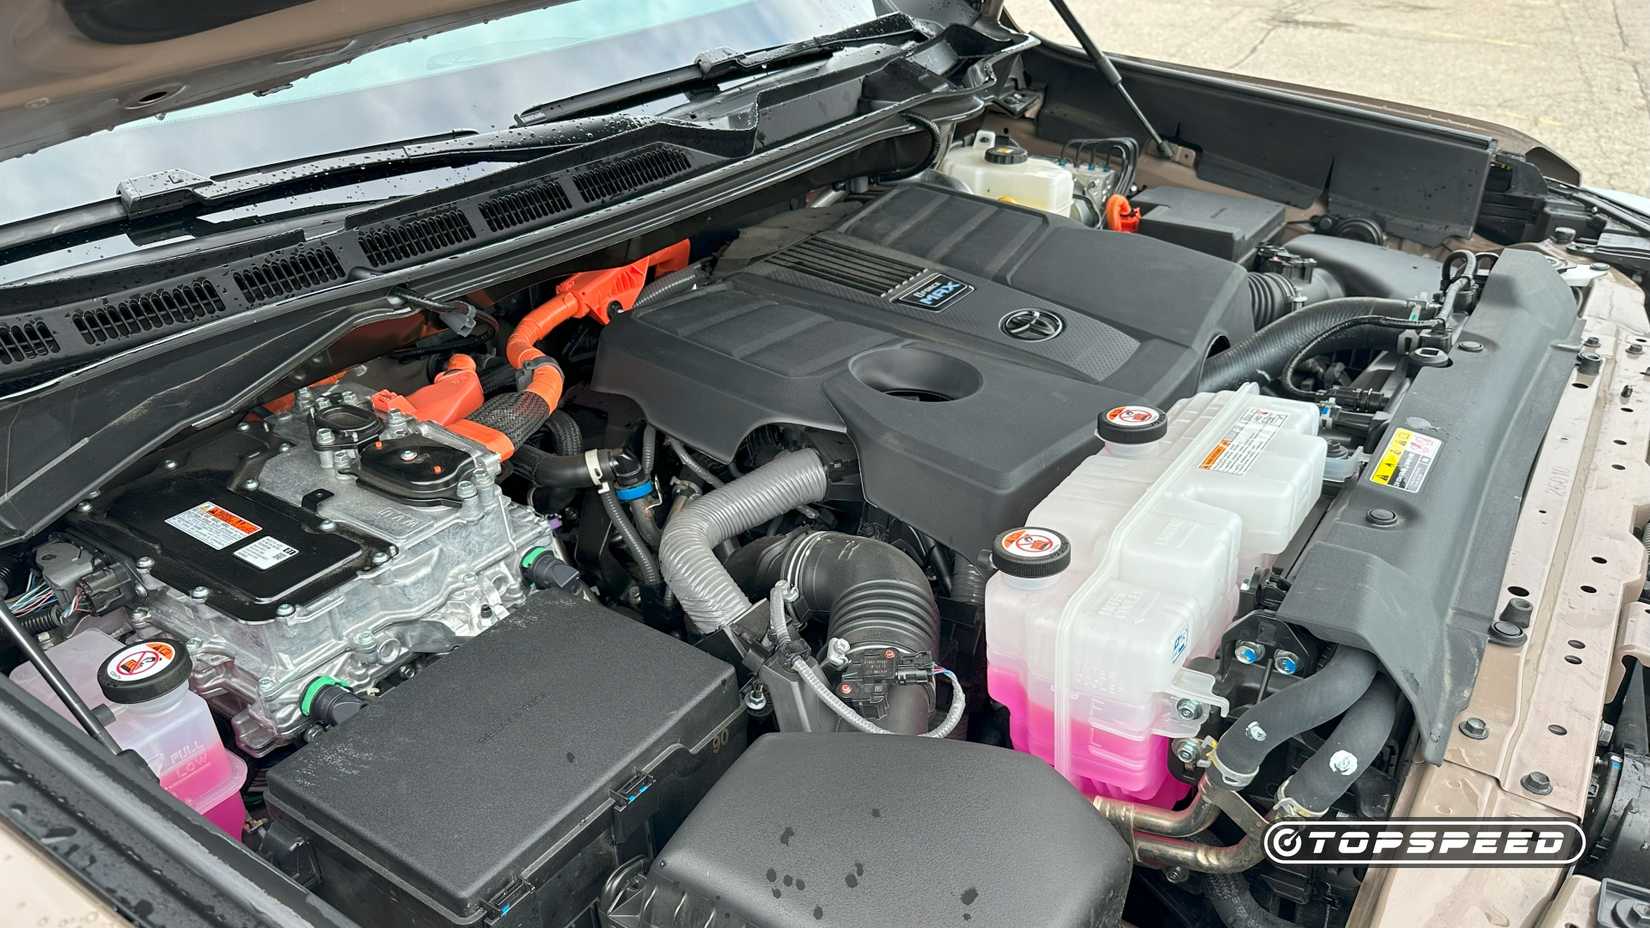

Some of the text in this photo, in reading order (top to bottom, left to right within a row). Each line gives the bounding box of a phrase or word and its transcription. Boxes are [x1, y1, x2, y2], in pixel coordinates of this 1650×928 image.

[919, 281, 960, 305] MAX
[712, 728, 729, 753] 90
[175, 752, 209, 777] LOW
